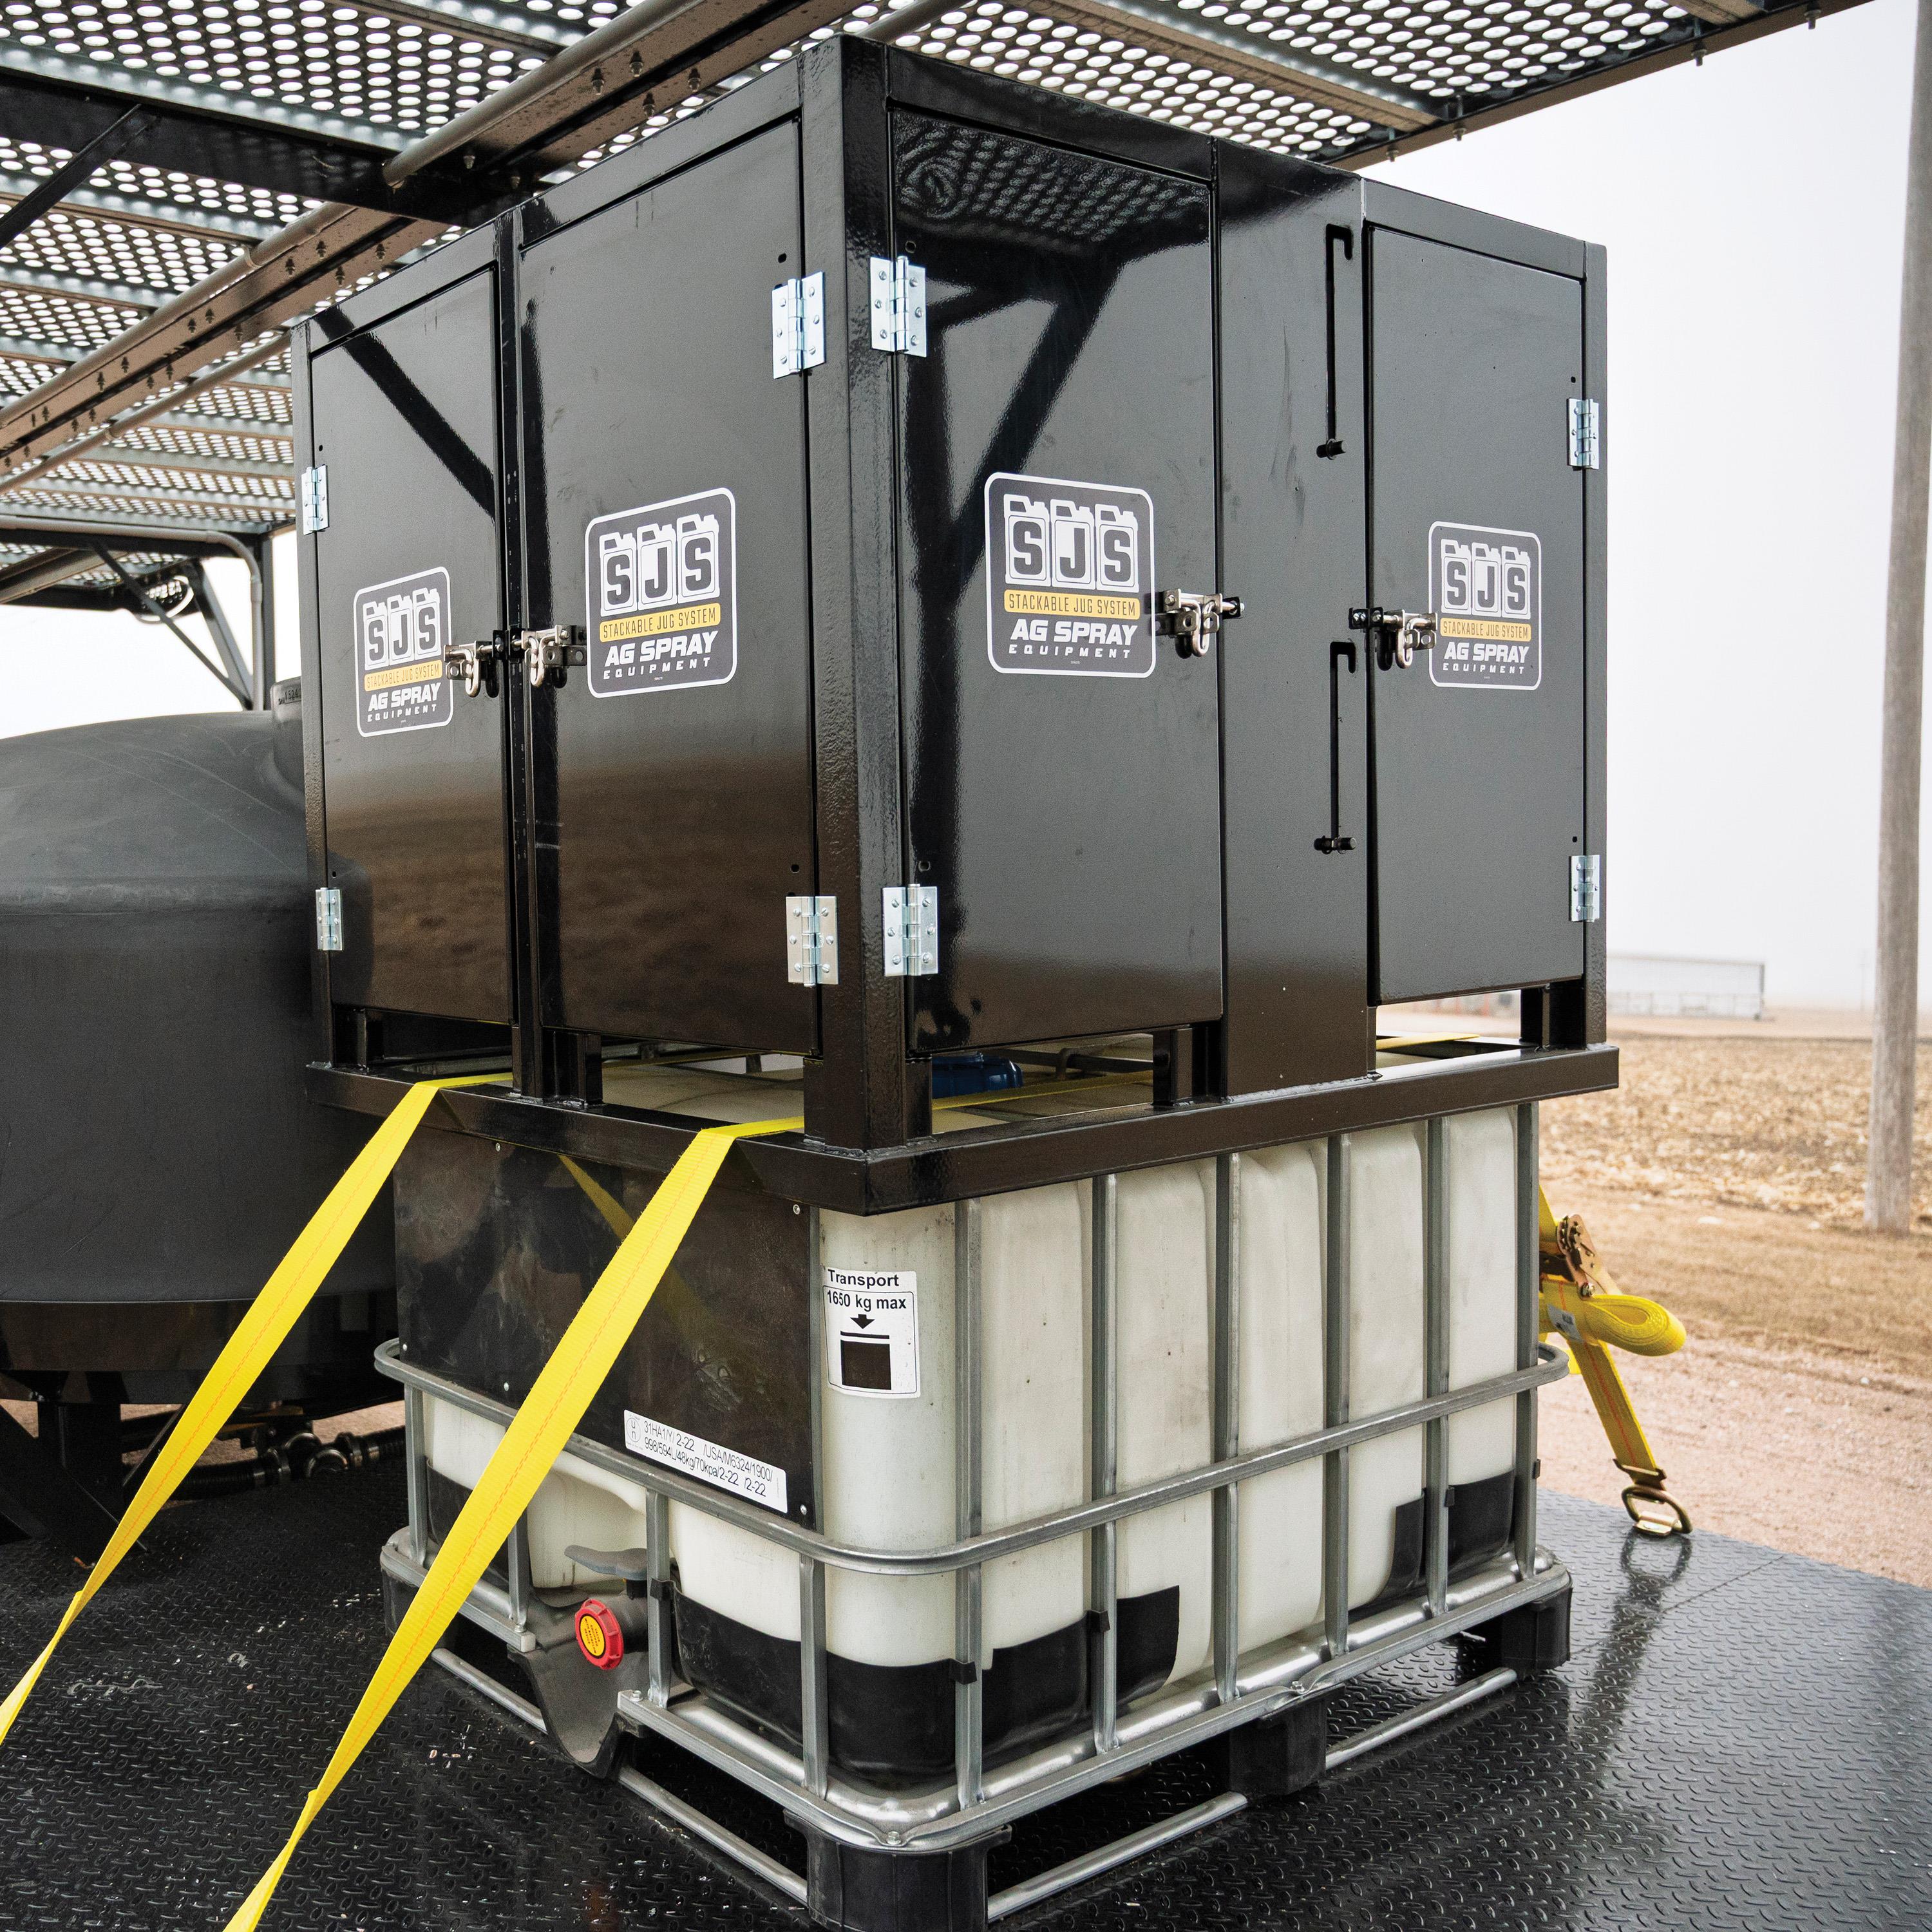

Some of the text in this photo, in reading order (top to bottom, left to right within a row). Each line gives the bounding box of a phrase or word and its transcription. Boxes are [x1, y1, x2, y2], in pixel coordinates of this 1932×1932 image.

[1013, 521, 1131, 582] SJS
[607, 537, 712, 605] SJS
[1446, 561, 1526, 611] SJS
[1009, 594, 1135, 616] STACKABLE JUG SYSTEM
[368, 607, 437, 661] SJS
[603, 607, 716, 639] STACKABLE JUG SYSTEM
[1010, 618, 1138, 645] AG SPRAY
[1443, 621, 1528, 639] STACKABLE JUG SYSTEM
[604, 630, 718, 667] AG SPRAY
[1009, 645, 1130, 659] EQUIPMENT
[1443, 641, 1530, 663] AG SPRAY
[366, 664, 440, 689] STACKABLE JUG SYSTEM
[603, 657, 710, 679] EQUIPMENT
[1443, 663, 1524, 674] EQUIPMENT
[368, 682, 441, 712] AG SPRAY
[367, 704, 437, 722] EQUIPMENT
[828, 1269, 900, 1289] Transport
[827, 1290, 907, 1312] 1650 kg max
